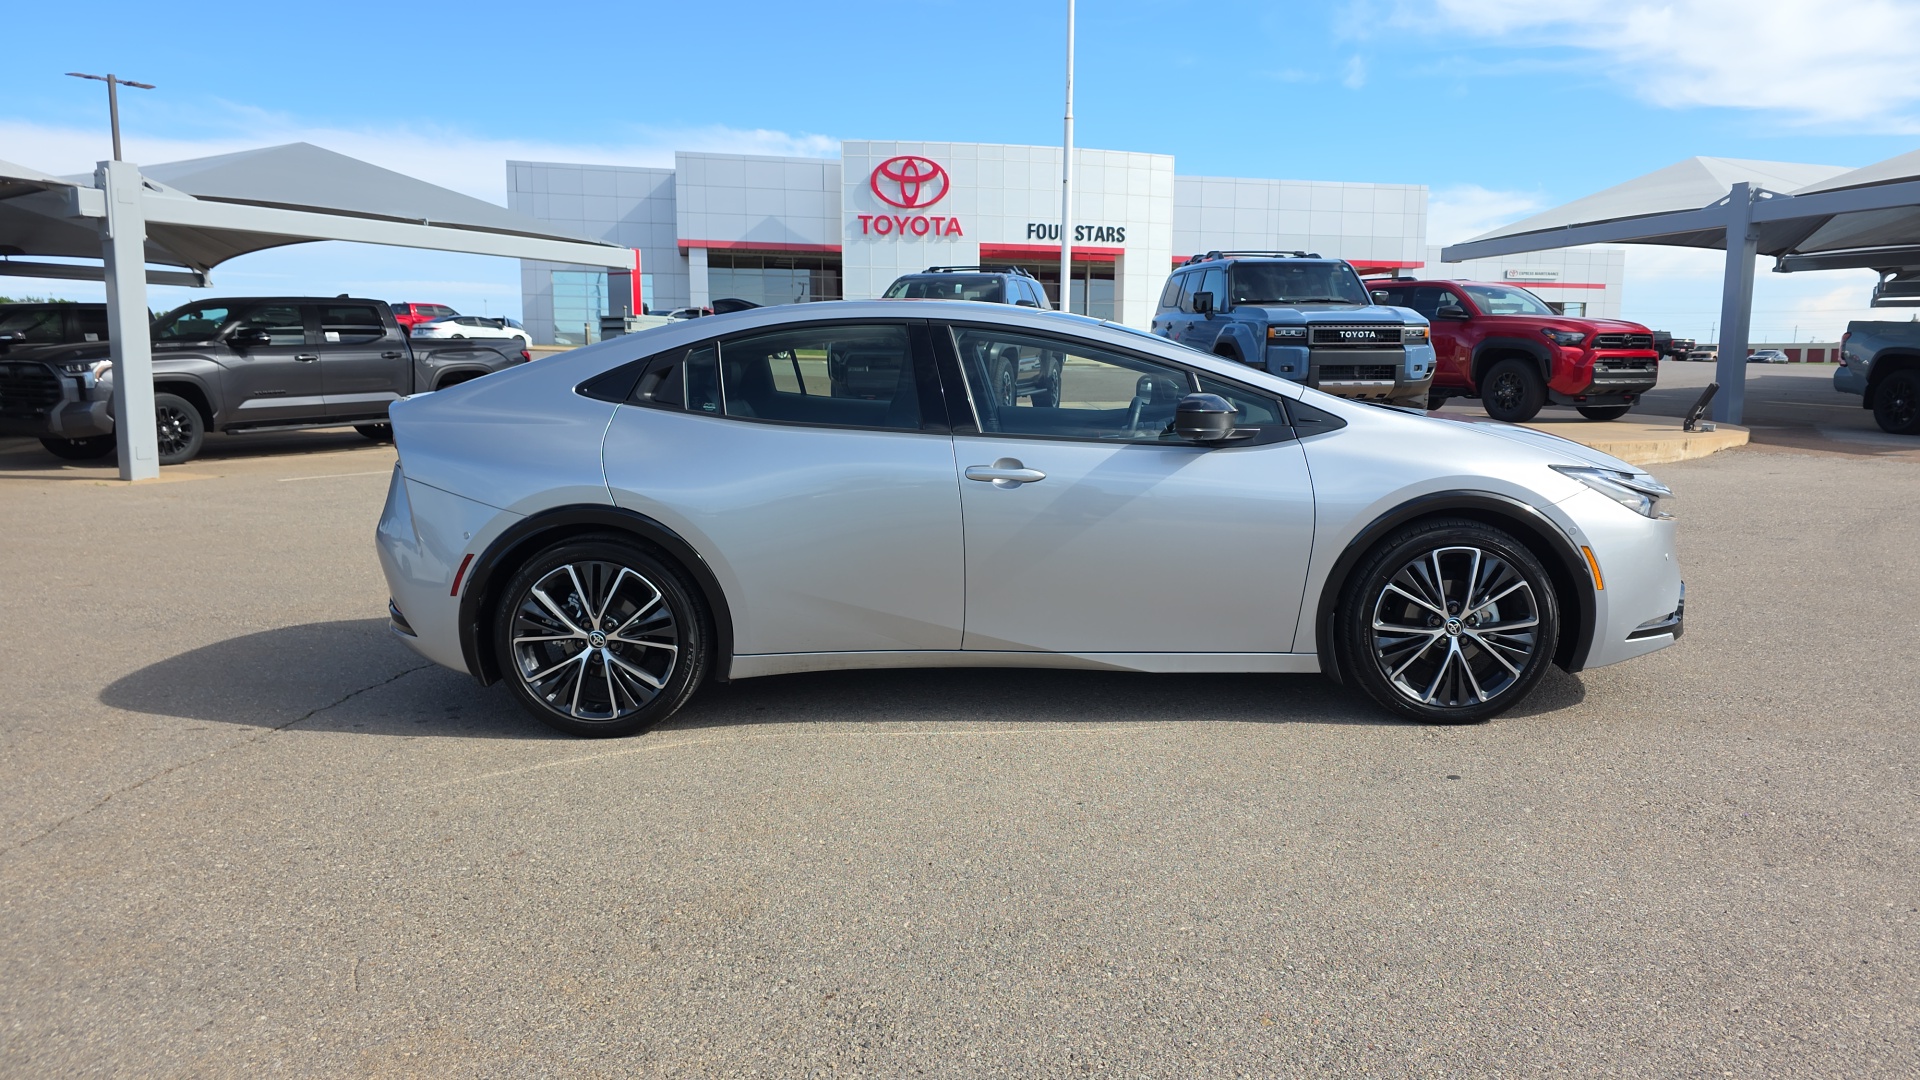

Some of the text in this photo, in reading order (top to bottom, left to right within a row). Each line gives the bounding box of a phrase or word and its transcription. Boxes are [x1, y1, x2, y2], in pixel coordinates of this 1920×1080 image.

[857, 215, 963, 236] TOYOTA
[1027, 223, 1125, 242] FOU STARS
